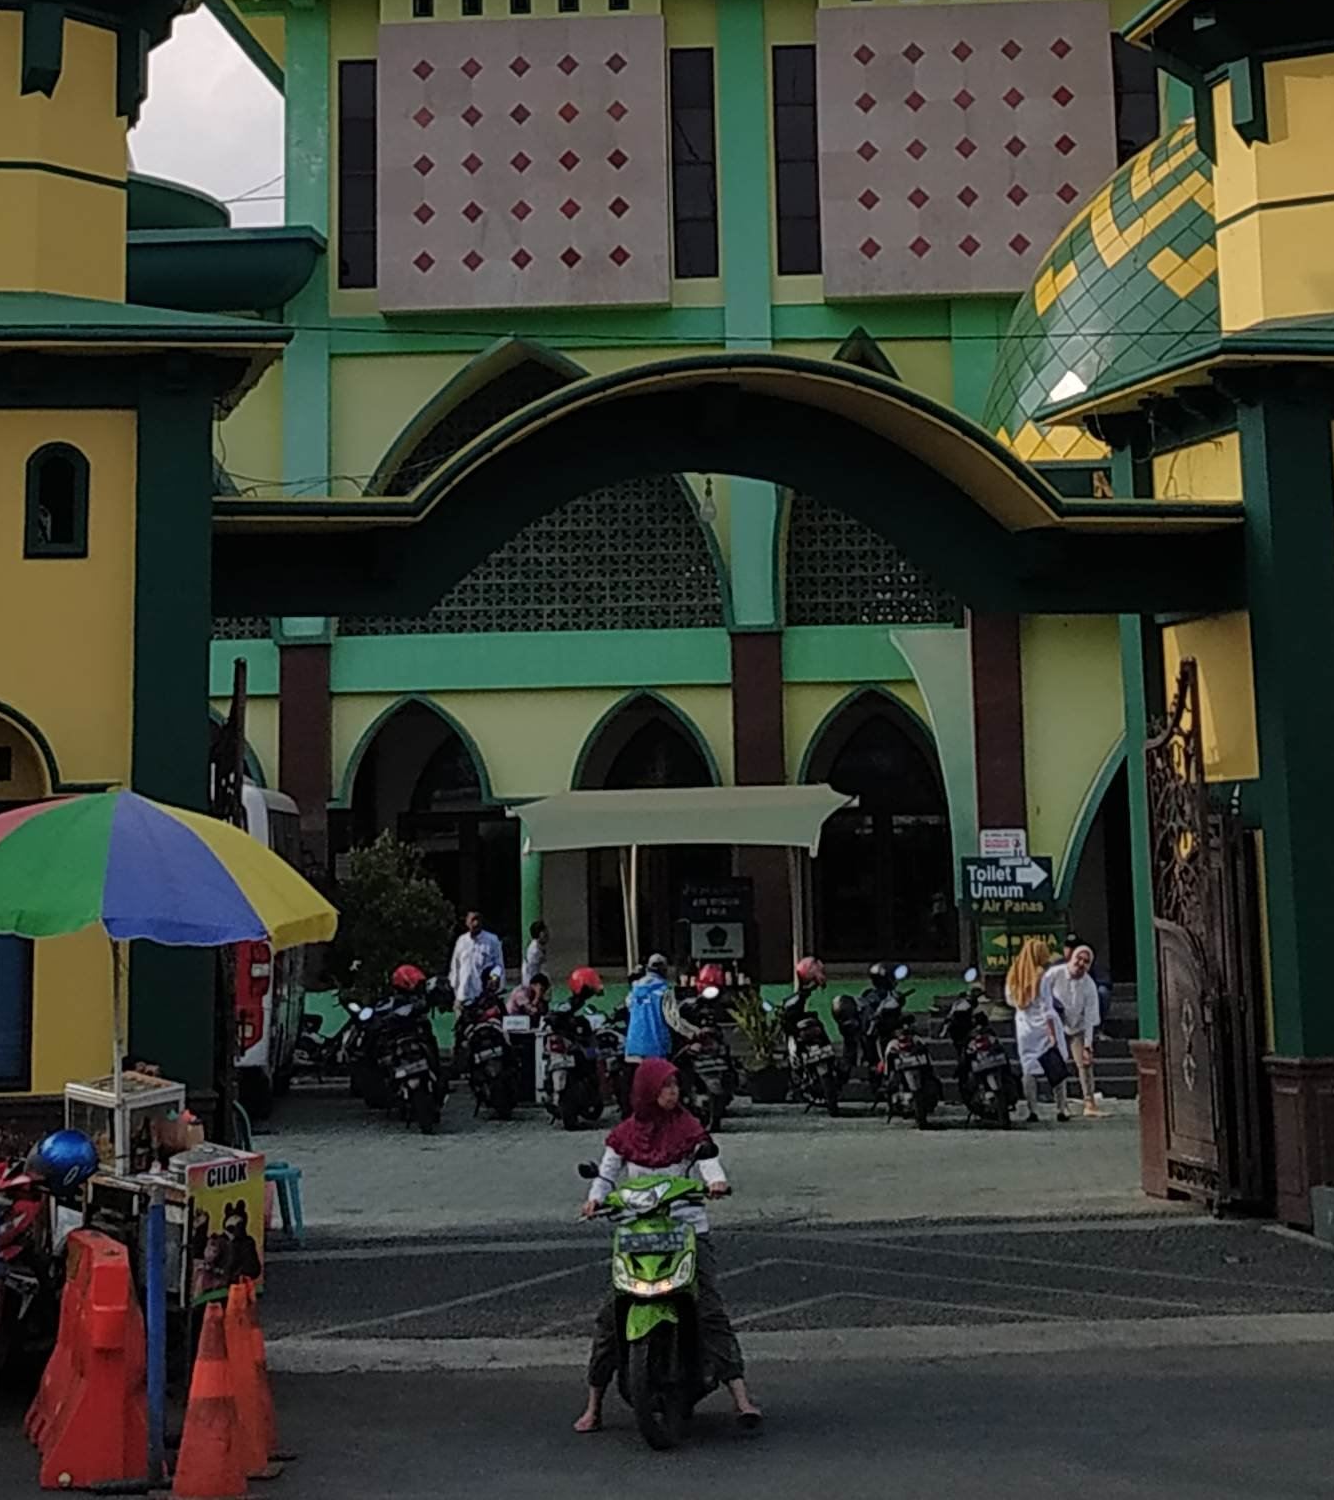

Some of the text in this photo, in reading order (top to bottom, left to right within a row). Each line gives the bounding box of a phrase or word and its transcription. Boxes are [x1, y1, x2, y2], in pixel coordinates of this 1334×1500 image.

[967, 864, 1013, 882] Toilet
[970, 881, 1024, 899] Umum
[982, 900, 1001, 912] Air
[1004, 900, 1044, 913] Panas
[207, 1162, 247, 1188] CILOK
